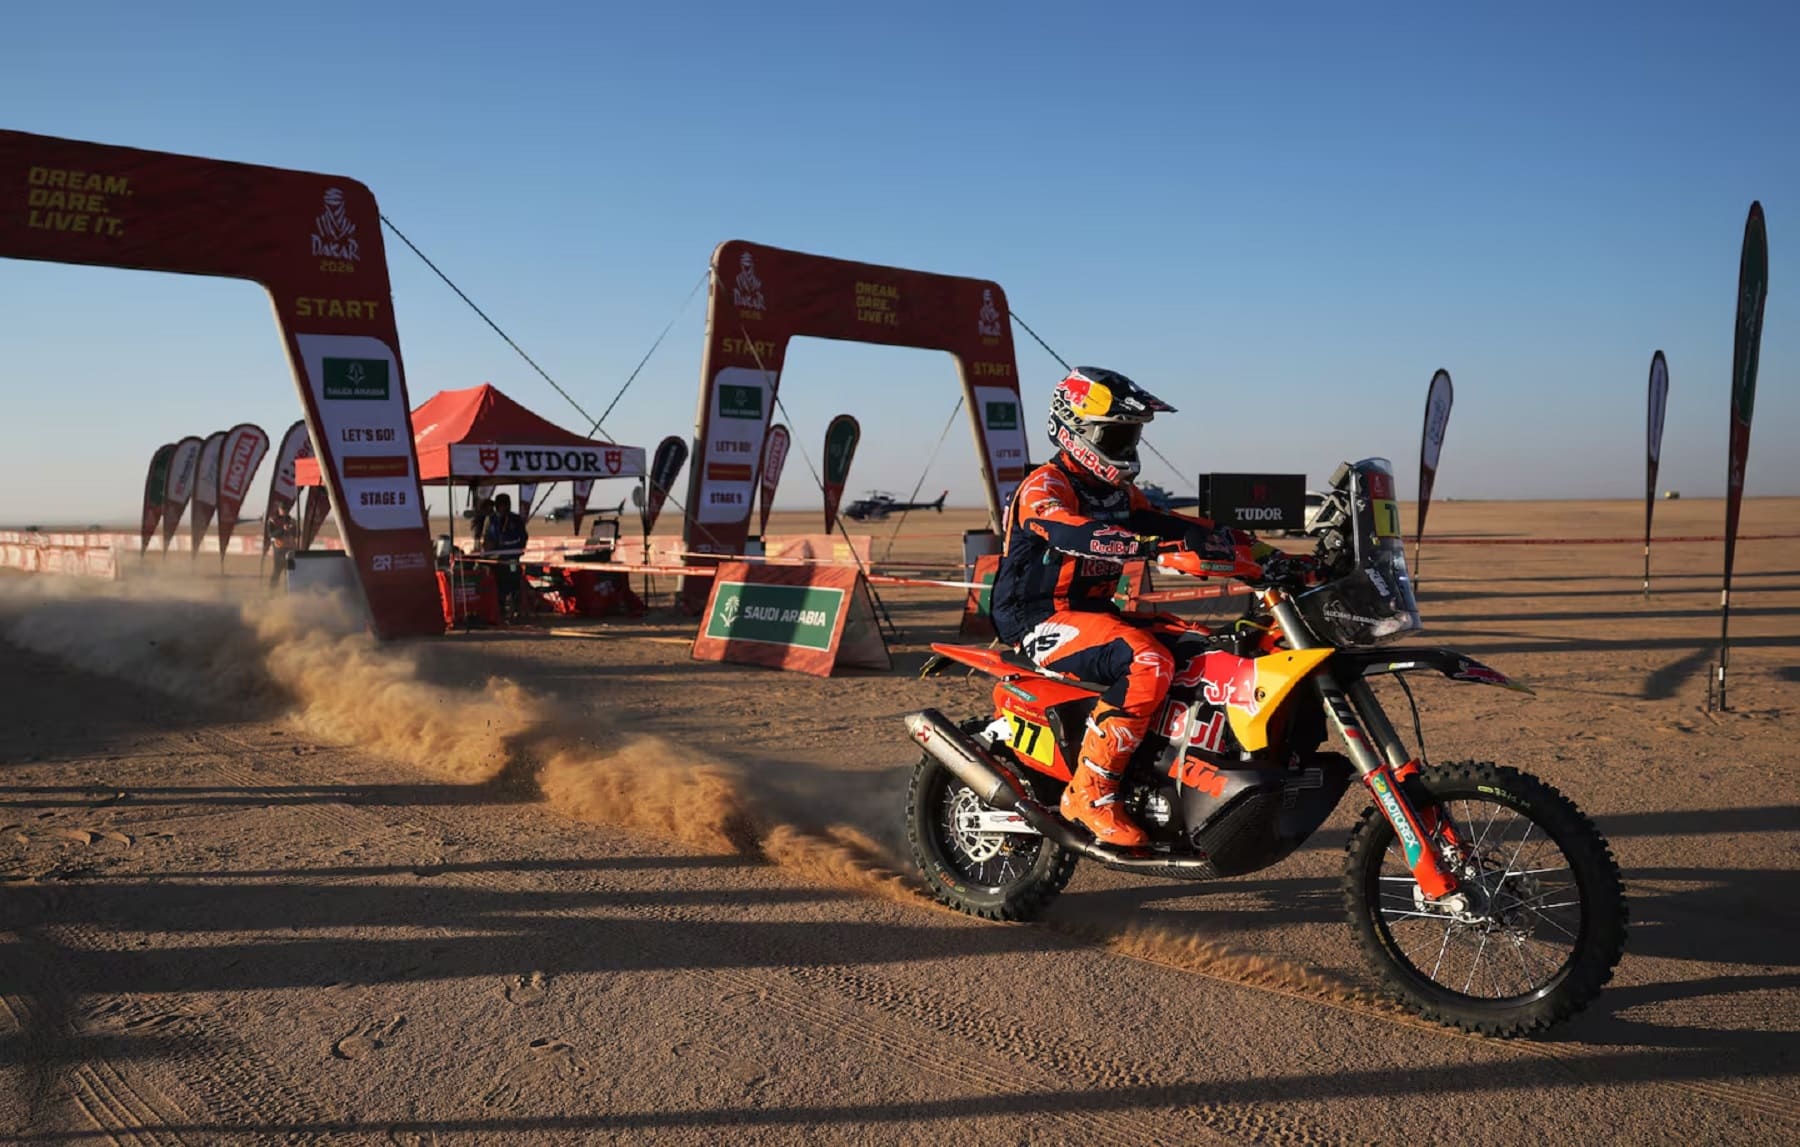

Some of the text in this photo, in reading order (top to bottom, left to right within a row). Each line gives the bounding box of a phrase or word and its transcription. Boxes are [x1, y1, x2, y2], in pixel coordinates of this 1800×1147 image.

[28, 166, 135, 196] DREAM.
[28, 188, 110, 213] DARE.
[28, 210, 126, 237] LIVE IT.
[295, 297, 379, 320] START
[722, 337, 776, 359] START
[342, 428, 396, 442] LET'S GO!
[229, 434, 257, 491] MOTUL
[506, 451, 600, 472] TUDOR
[360, 492, 396, 505] STAGE
[1234, 507, 1283, 521] TUDOR
[743, 605, 827, 627] SAUDI ARABIA
[1013, 715, 1042, 756] 77
[1168, 754, 1229, 799] KTM
[1381, 792, 1419, 849] MOTOREX
